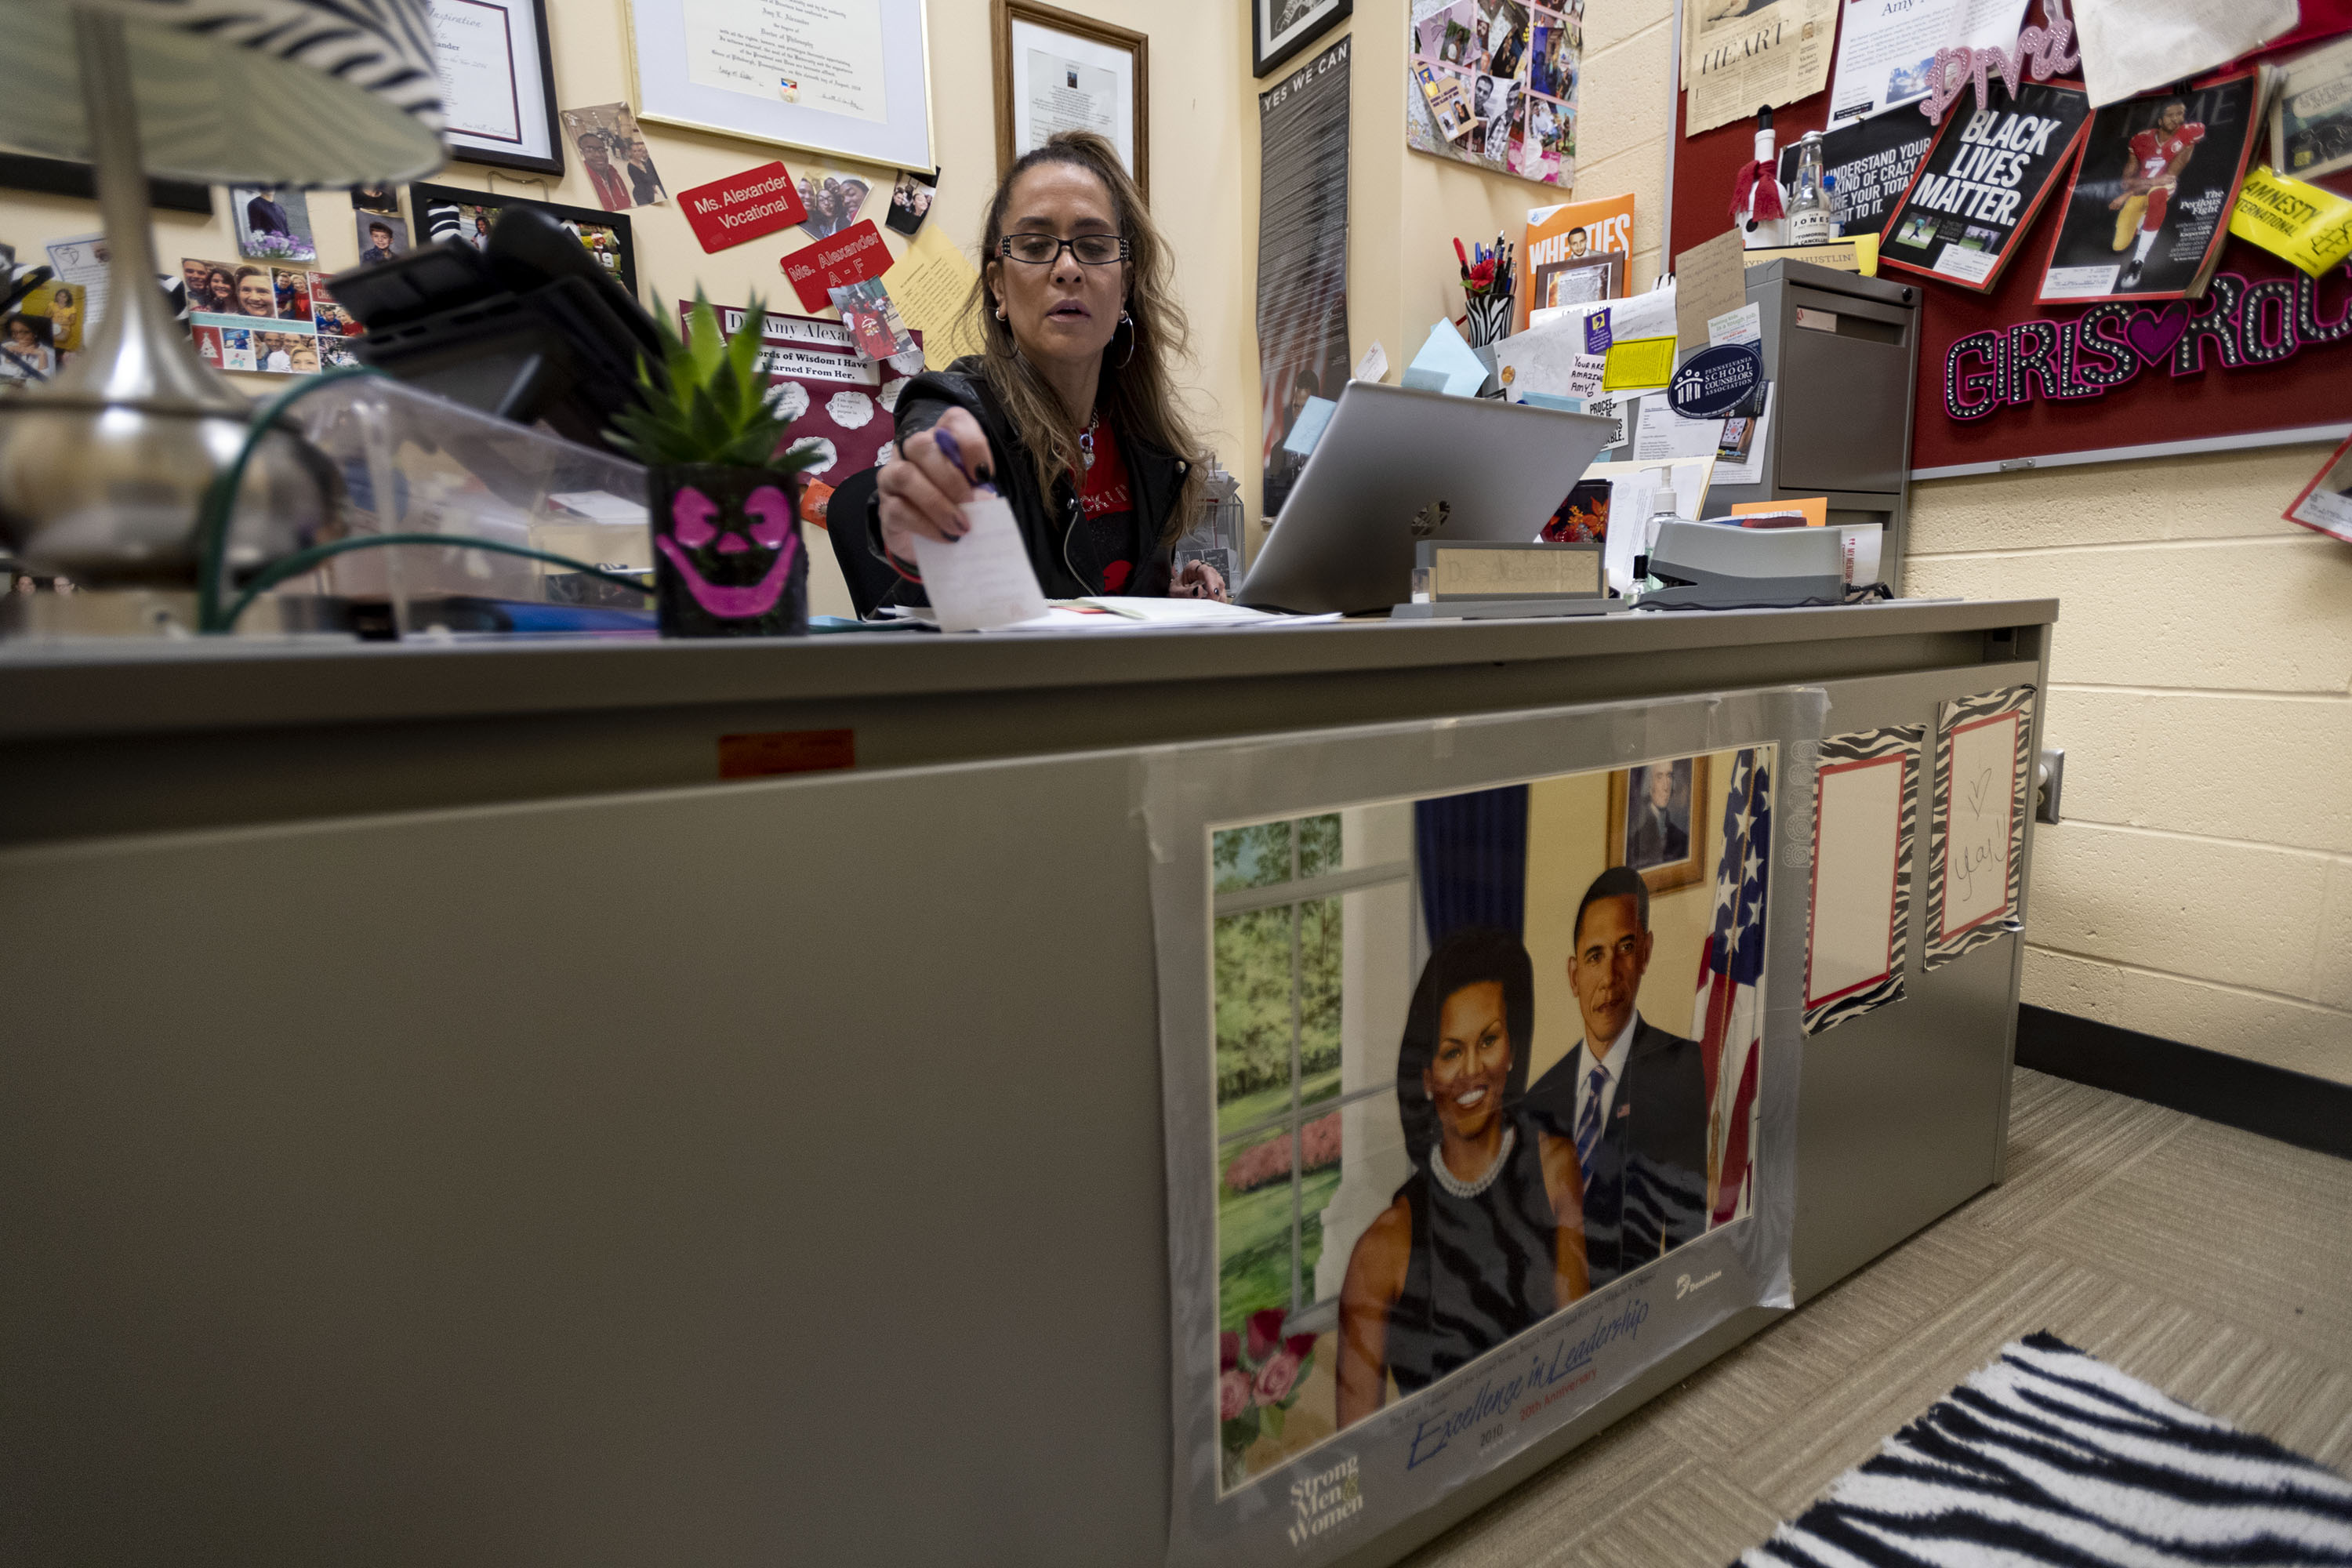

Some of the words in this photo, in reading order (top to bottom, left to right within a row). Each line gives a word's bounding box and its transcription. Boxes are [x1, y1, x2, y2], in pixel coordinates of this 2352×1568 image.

[1702, 20, 1790, 75] HEART
[1265, 86, 1287, 111] YES
[1293, 68, 1312, 93] WE
[1318, 43, 1347, 74] CAN
[1959, 108, 2063, 156] BLACK
[1825, 149, 1896, 180] UNDERSTAND
[1900, 137, 1932, 158] YOUR
[1835, 176, 1860, 194] KIND
[1863, 171, 1877, 187] OF
[1880, 158, 1918, 182] CRAZY
[1947, 143, 2031, 188] LIVES
[2144, 159, 2166, 179] 7
[694, 198, 723, 216] Ms.
[722, 176, 787, 207] Alexander
[717, 195, 789, 230] Vocational
[1851, 187, 1880, 205] YOUR
[1856, 203, 1870, 220] TO
[1871, 198, 1883, 216] IT.
[1911, 172, 2022, 227] MATTER.
[2180, 198, 2222, 209] Perilous
[2192, 205, 2220, 216] Fight
[2205, 191, 2224, 199] The
[2243, 180, 2325, 225] AMNESTY
[1794, 216, 1830, 227] JONES
[2234, 199, 2299, 238] TERNATIONAL
[788, 263, 816, 282] Ms.
[817, 231, 879, 270] Alexander
[1529, 212, 1631, 274] WHETIES
[828, 270, 841, 287] A
[853, 258, 865, 274] F
[764, 318, 798, 339] Amy
[782, 351, 793, 361] of
[795, 353, 835, 365] Wisdom
[837, 358, 842, 366] I
[843, 359, 868, 370] Have
[805, 367, 837, 377] From
[839, 369, 855, 379] Her.
[1704, 356, 1752, 375] PENNSYLVANIA
[1704, 363, 1753, 382] SCHOOL
[1944, 302, 2141, 420] GIRLS
[1704, 370, 1754, 390] COUNSELORS
[1705, 378, 1752, 397] ASSOCIATION
[1589, 398, 1617, 416] PROCEE
[1690, 1270, 1722, 1293] Dominion
[1406, 1376, 1523, 1471] Excellence
[1528, 1356, 1544, 1388] in
[1544, 1298, 1649, 1385] Leadership
[1544, 1367, 1598, 1406] Anniversary
[1480, 1423, 1504, 1447] 2010
[1290, 1455, 1359, 1500] Strong
[1288, 1494, 1363, 1548] Women
[1298, 1485, 1342, 1522] Men
